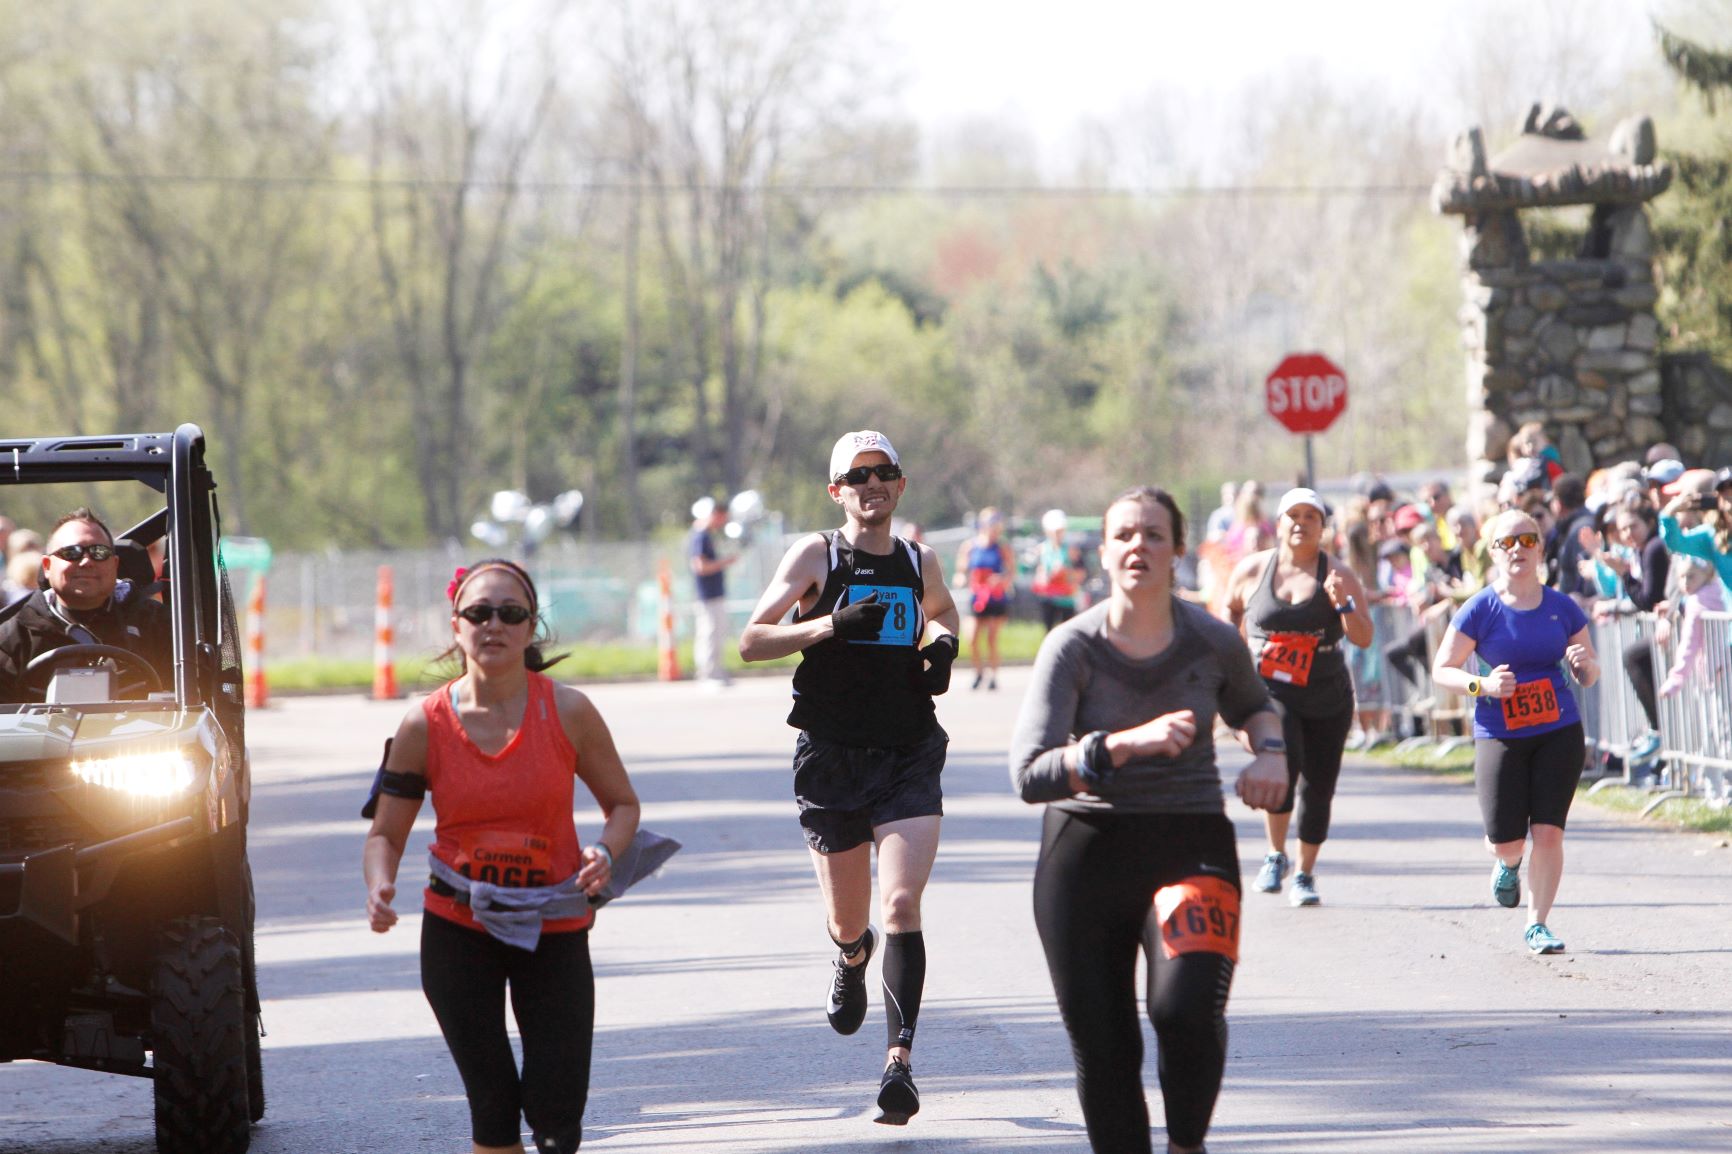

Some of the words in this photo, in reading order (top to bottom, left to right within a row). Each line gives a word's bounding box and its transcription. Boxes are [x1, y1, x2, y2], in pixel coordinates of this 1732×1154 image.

[1270, 375, 1345, 413] STOP
[1505, 690, 1555, 719] 1538
[473, 848, 533, 864] Carmen
[1166, 905, 1238, 942] 1697
